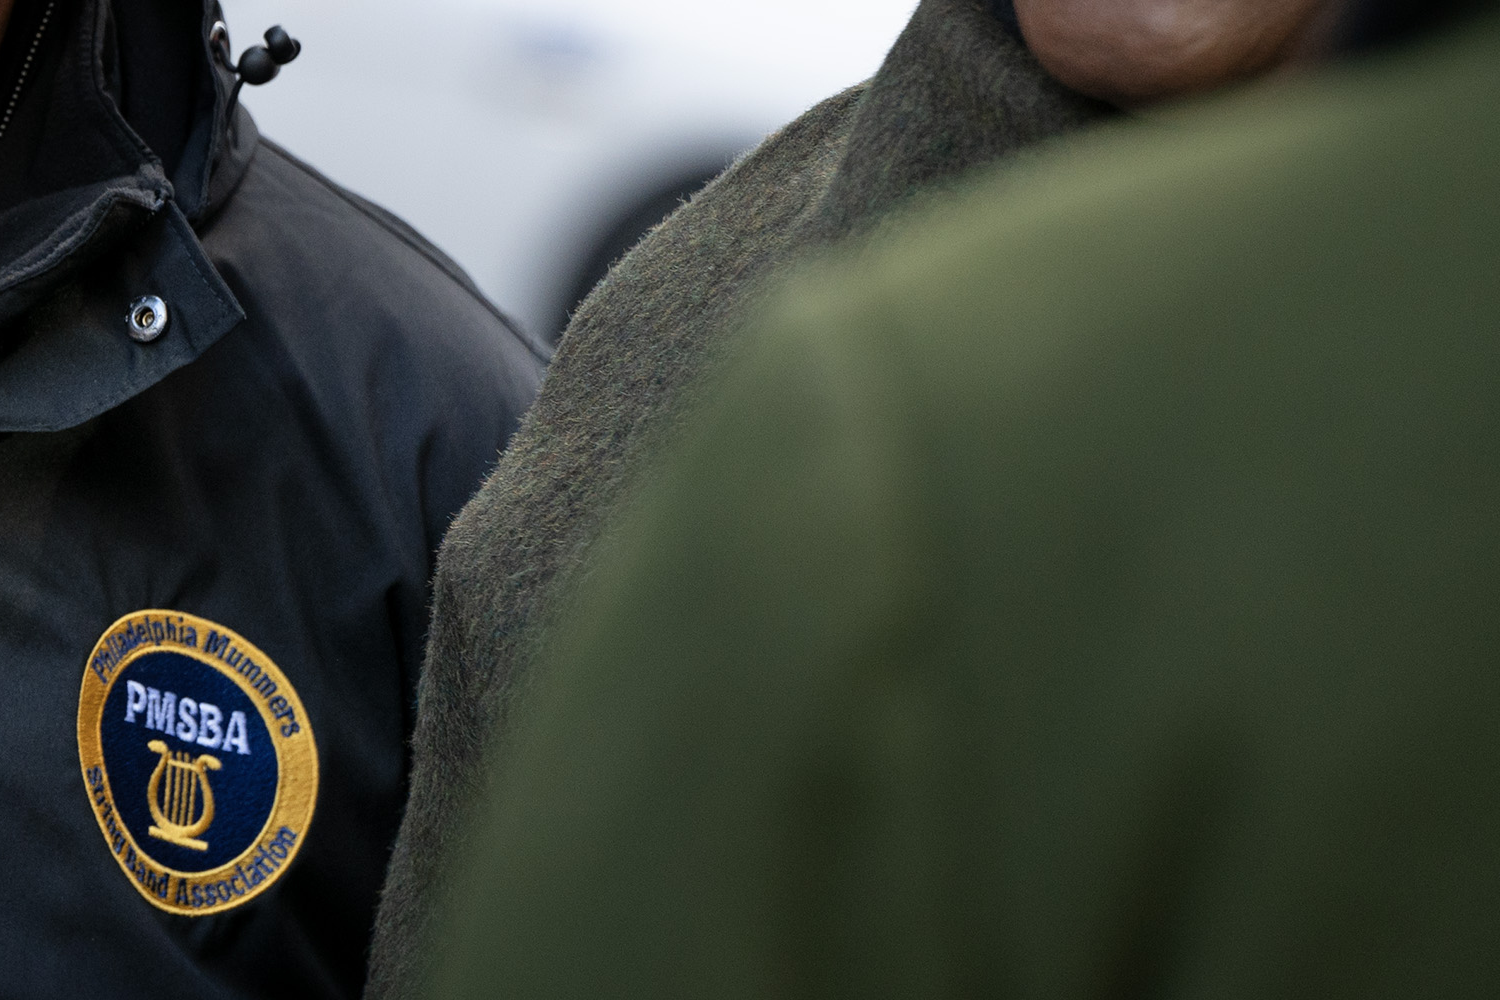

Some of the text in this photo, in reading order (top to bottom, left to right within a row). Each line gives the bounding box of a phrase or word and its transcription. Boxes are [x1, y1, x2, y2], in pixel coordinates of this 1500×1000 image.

[91, 615, 300, 737] Philadelphia Mummers
[124, 680, 251, 755] PMSBA
[87, 765, 298, 909] String Band Association
